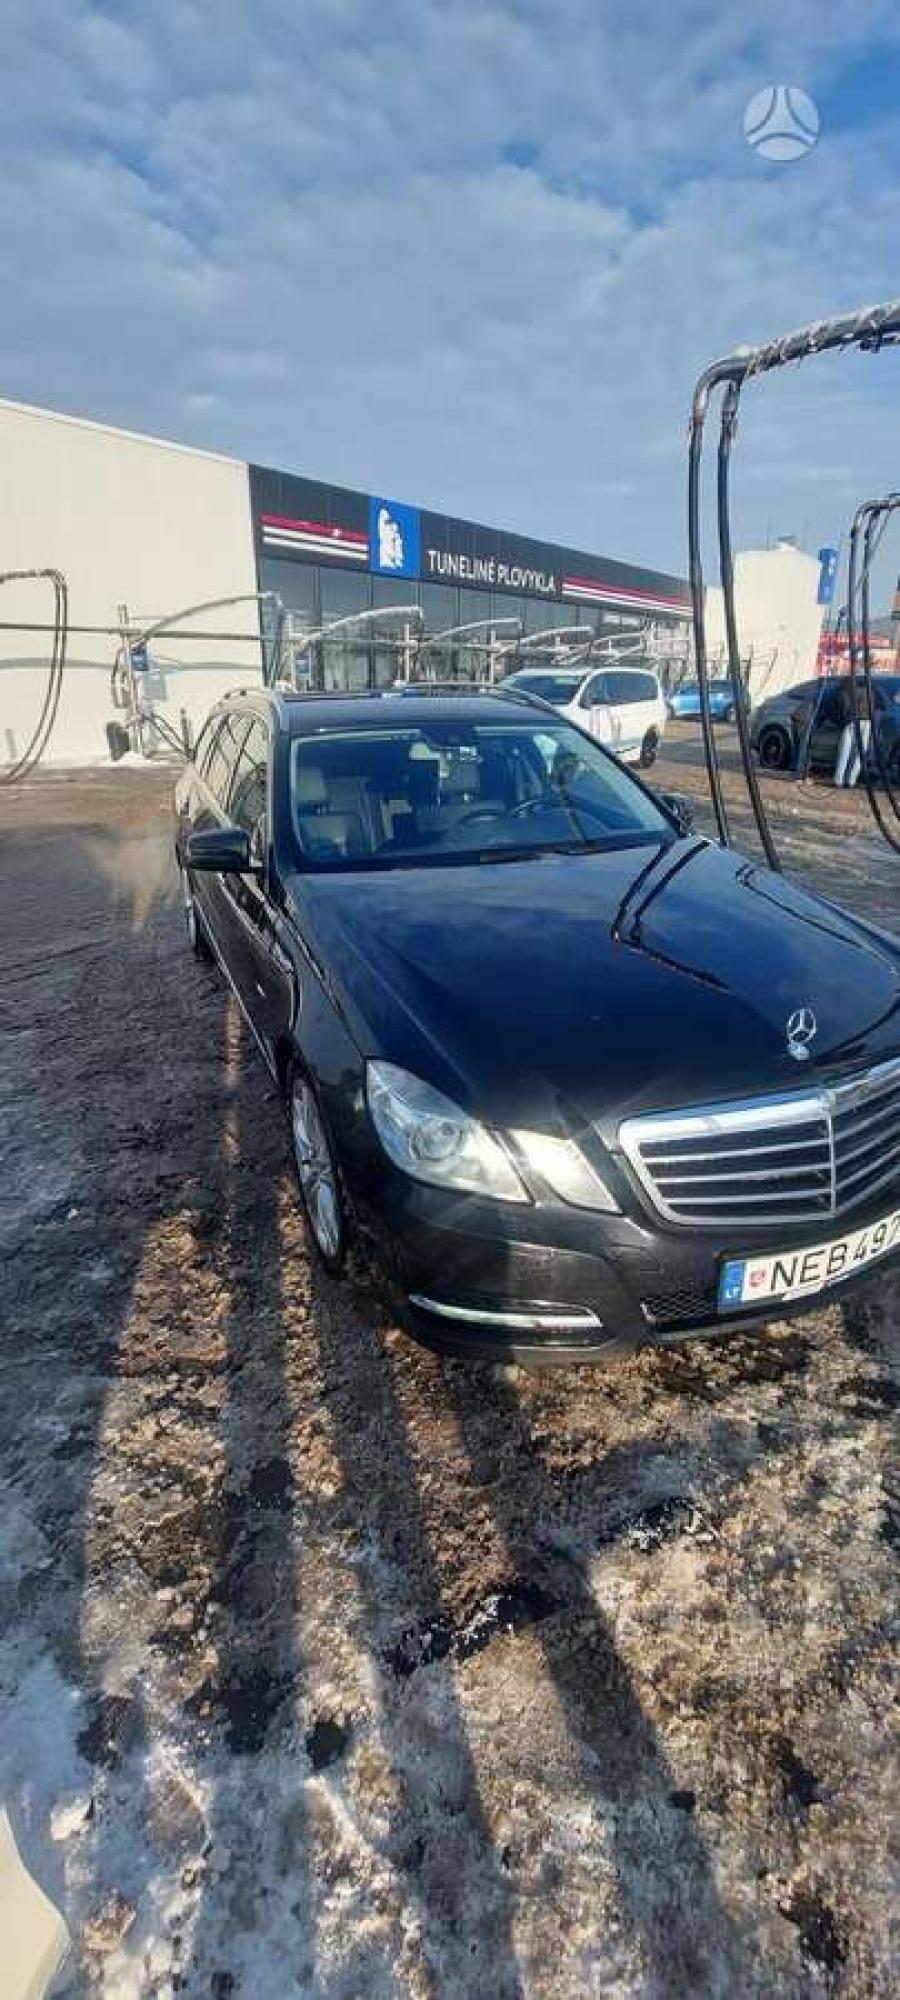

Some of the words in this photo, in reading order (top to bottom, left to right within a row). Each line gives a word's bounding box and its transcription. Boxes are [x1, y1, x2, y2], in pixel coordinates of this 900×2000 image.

[497, 564, 557, 592] PLOVYKLA
[771, 1243, 848, 1291] NEB
[853, 1215, 900, 1260] 497
[726, 1286, 742, 1299] LT
